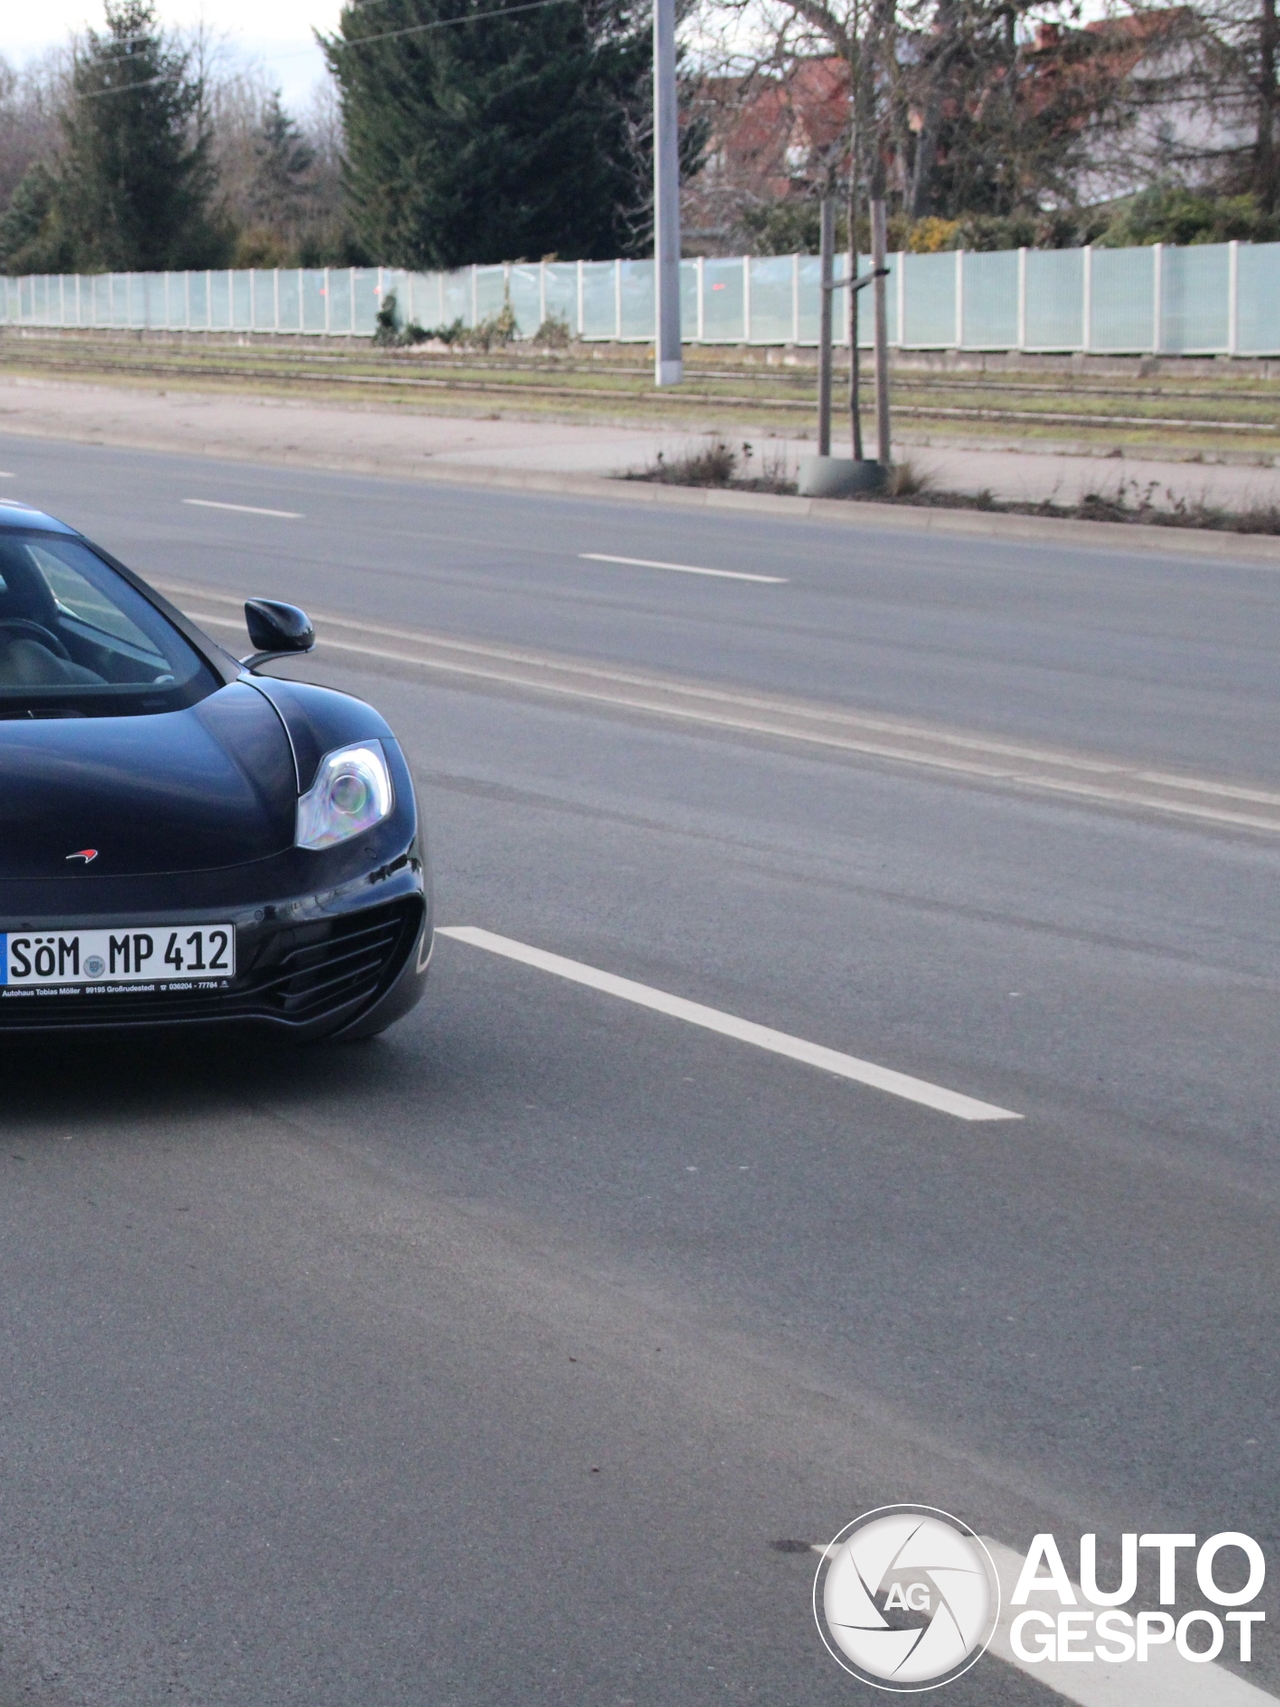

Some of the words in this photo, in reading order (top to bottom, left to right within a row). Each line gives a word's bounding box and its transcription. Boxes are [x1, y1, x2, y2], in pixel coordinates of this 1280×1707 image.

[10, 937, 80, 977] SÖM
[108, 933, 154, 974] MP
[163, 930, 228, 971] 412
[2, 989, 34, 997] Autohaus
[36, 988, 58, 996] Tobias
[59, 987, 81, 995] Möller
[198, 981, 218, 989] 77784
